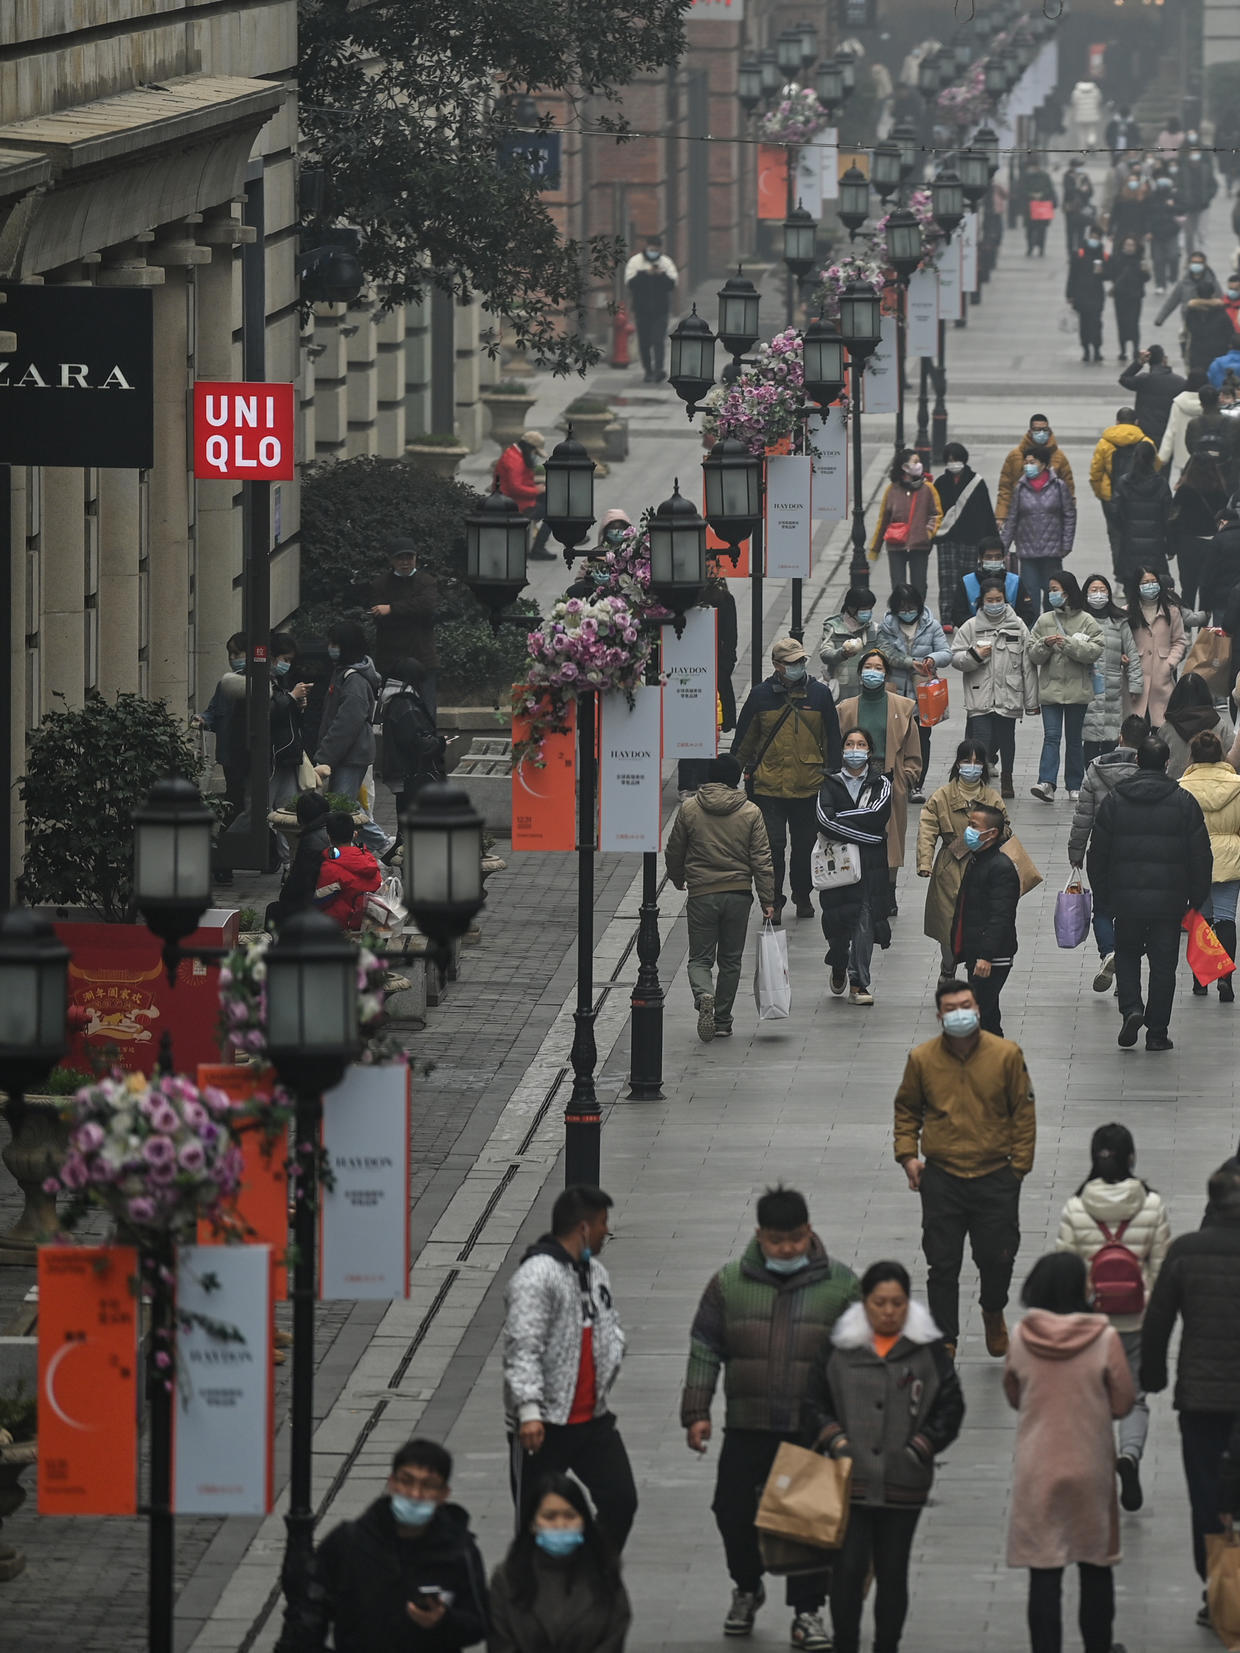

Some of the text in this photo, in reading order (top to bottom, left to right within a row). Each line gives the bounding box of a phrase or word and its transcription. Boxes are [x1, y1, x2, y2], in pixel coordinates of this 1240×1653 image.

[0, 362, 135, 390] ARA
[205, 395, 274, 428] UNI
[205, 435, 281, 473] QLO
[611, 751, 651, 759] HAYDON
